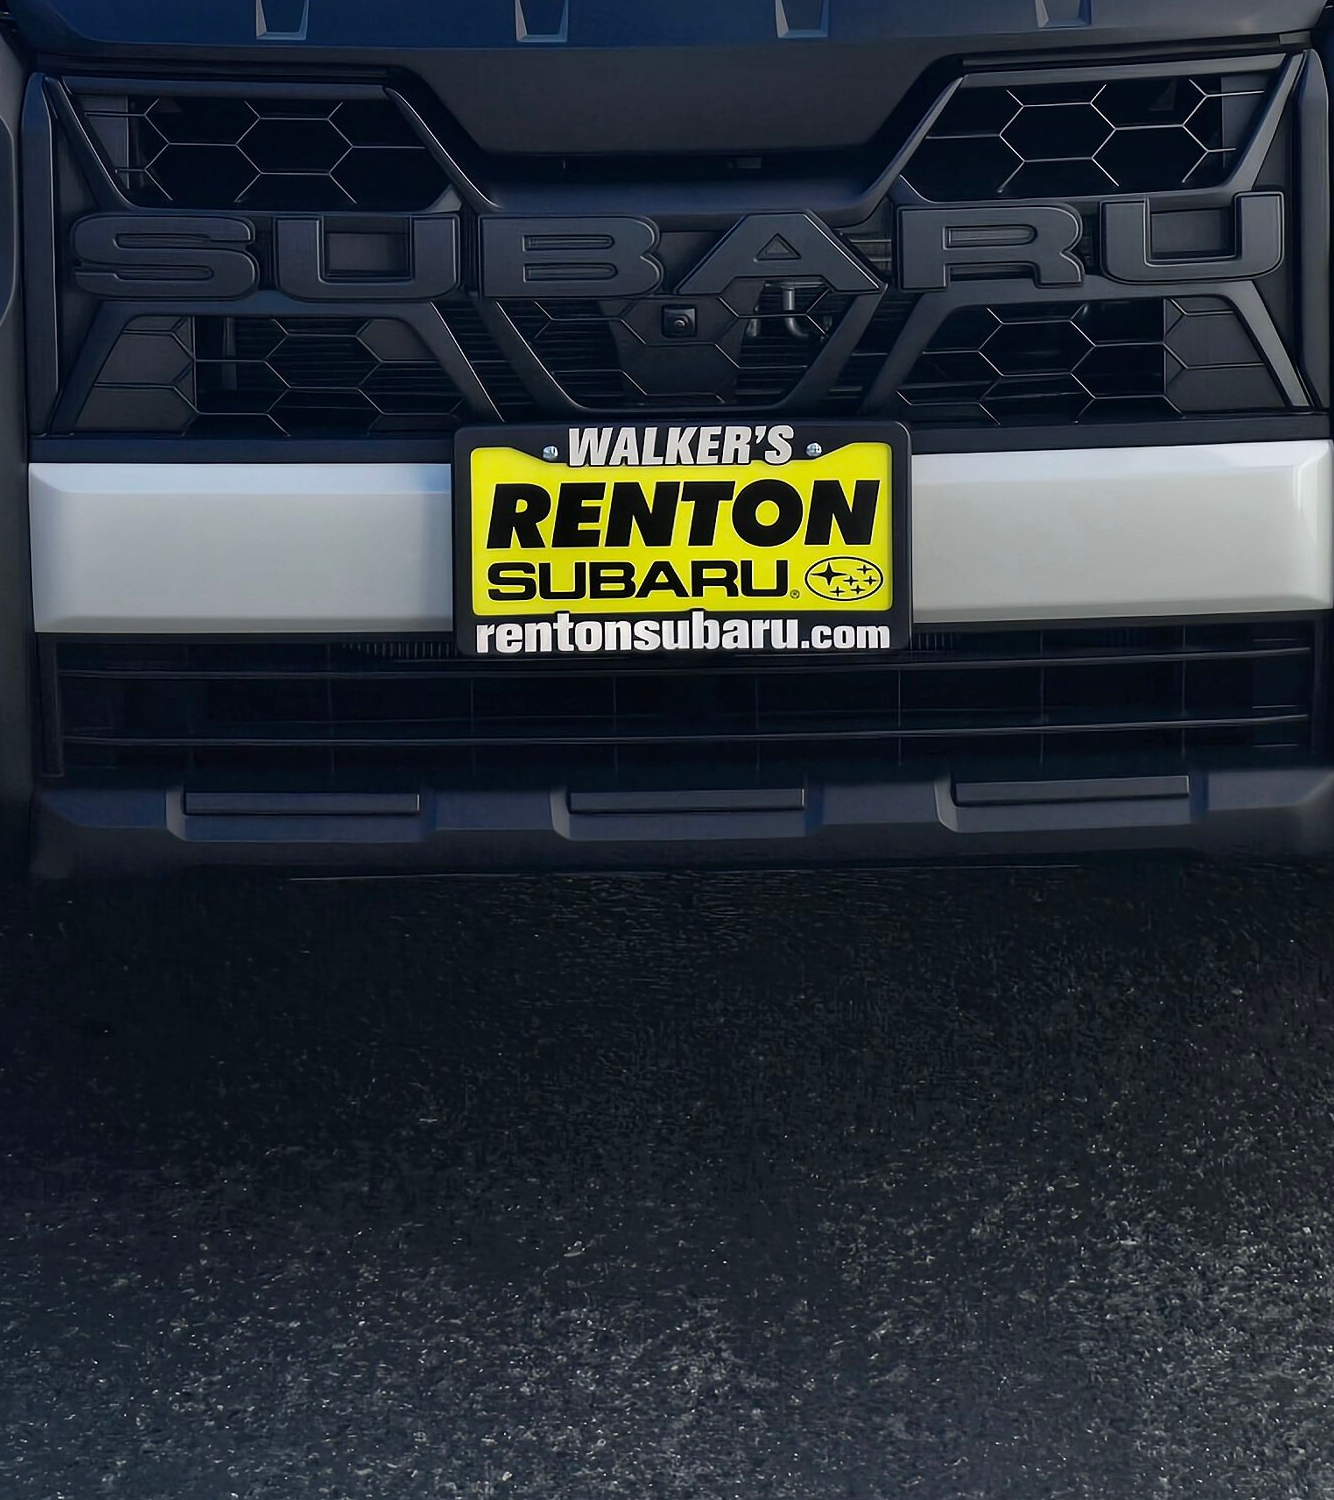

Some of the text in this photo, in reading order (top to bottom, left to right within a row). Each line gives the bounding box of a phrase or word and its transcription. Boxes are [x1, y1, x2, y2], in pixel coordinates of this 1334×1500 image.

[72, 192, 1285, 299] SUBARU
[569, 425, 795, 467] WALKER'S
[486, 480, 881, 549] RENTON
[487, 560, 789, 601] SUBARU
[476, 612, 890, 653] rentonsubaru.com
